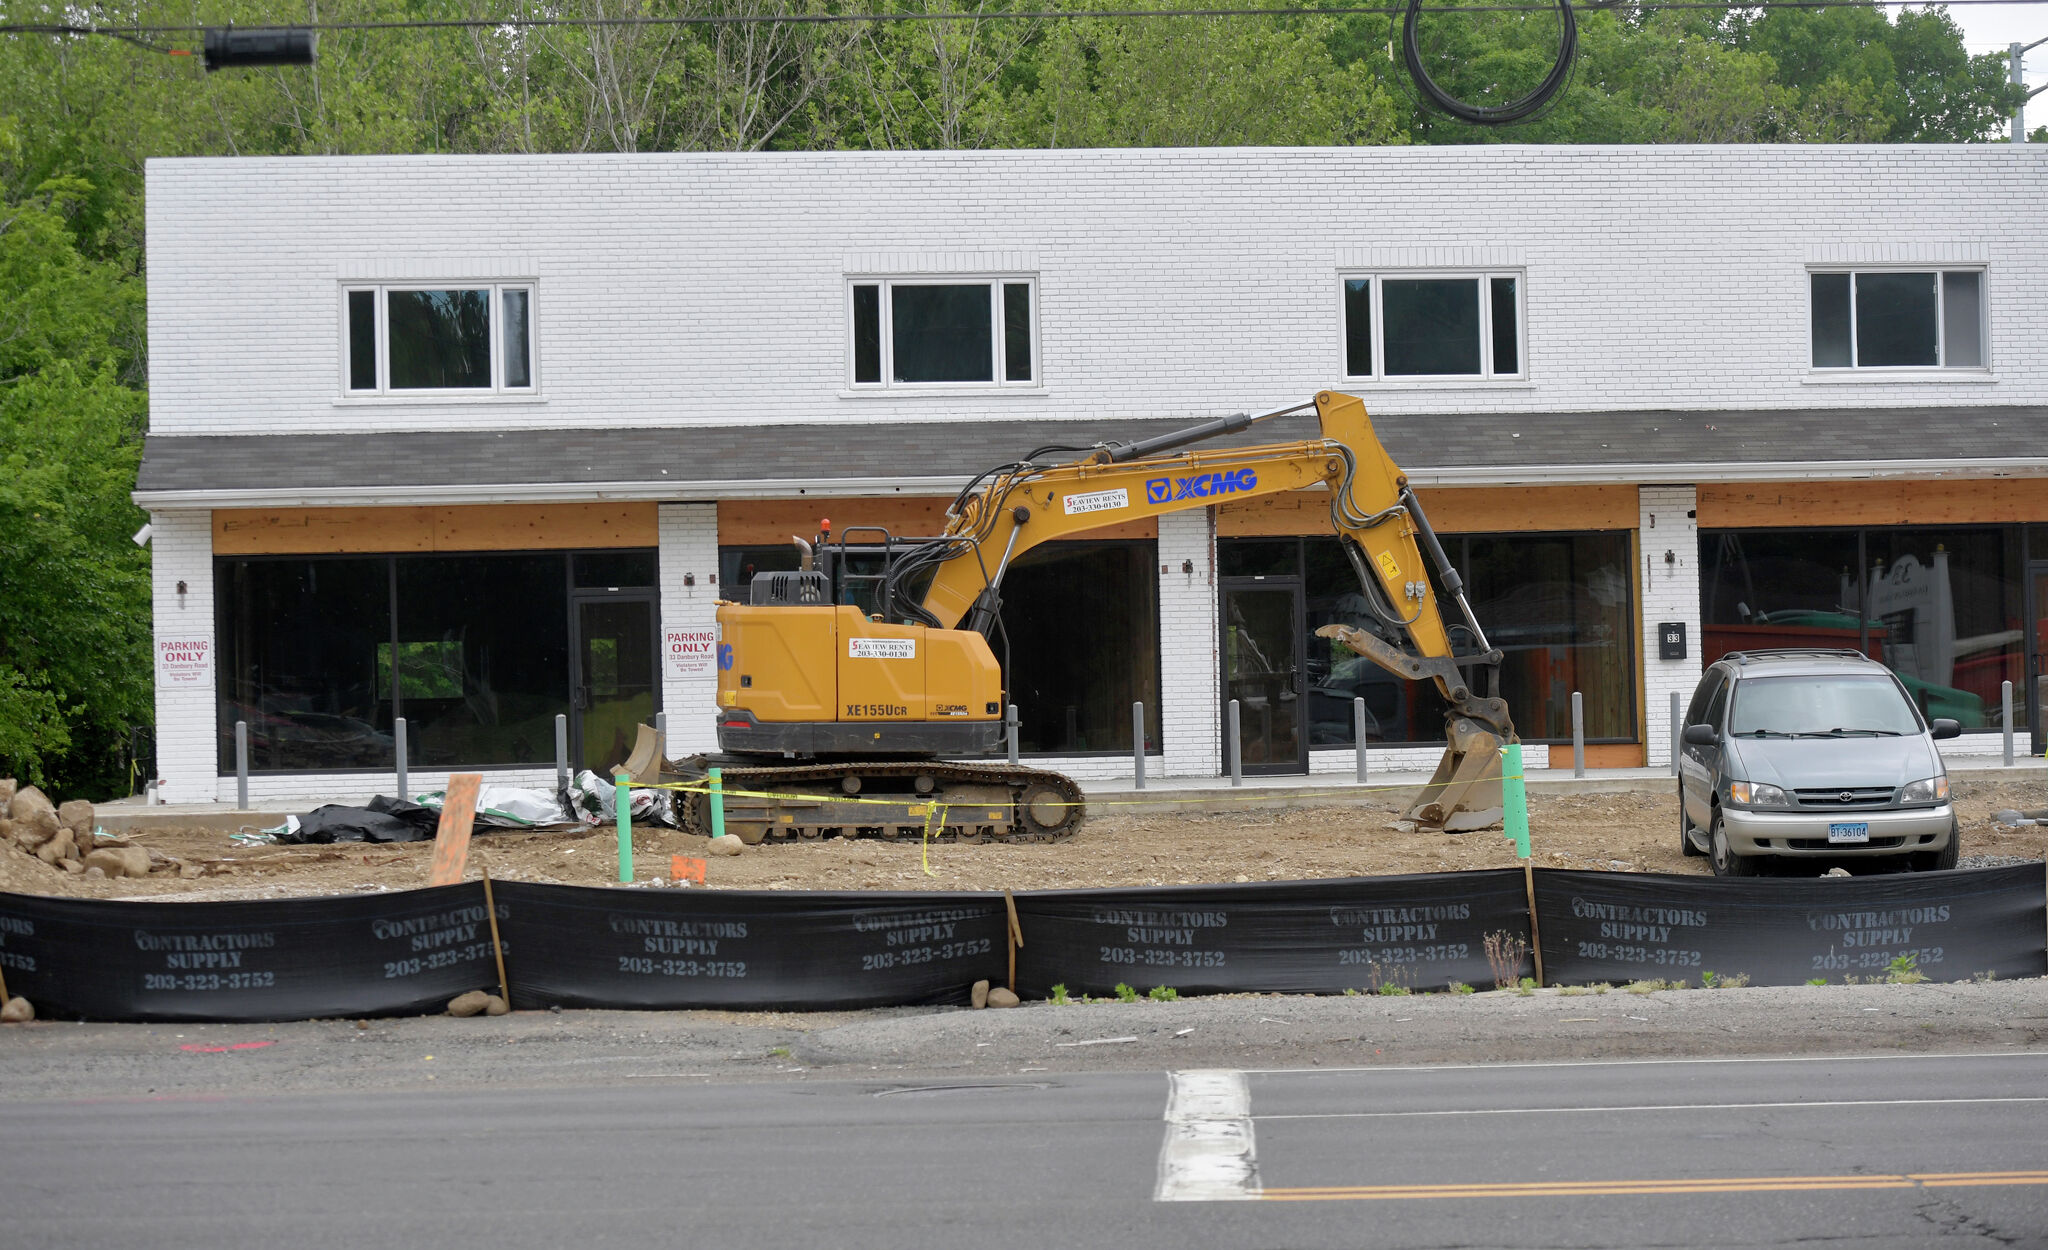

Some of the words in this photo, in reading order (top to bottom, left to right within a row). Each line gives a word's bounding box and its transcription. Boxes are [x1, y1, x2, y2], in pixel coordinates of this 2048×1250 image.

[1175, 468, 1257, 500] XCMG
[1067, 496, 1100, 507] SEAVIEW
[1102, 494, 1126, 502] RENTS
[1072, 501, 1121, 513] 203-330-0130
[160, 641, 208, 651] PARKING
[668, 632, 714, 642] PARKING
[852, 640, 886, 650] SEAVIEW
[1668, 634, 1679, 642] 33
[165, 652, 204, 662] ONLY
[672, 643, 710, 653] ONLY
[857, 650, 908, 658] 203-330-0130
[846, 704, 907, 716] XE155UCR
[1330, 904, 1471, 927] CONTRACTORS
[1571, 896, 1707, 927] CONTRACTORS
[1808, 905, 1951, 932] CONTRACTORS
[609, 914, 748, 938] CONTRACTORS
[886, 922, 956, 946] SUPPLY
[1127, 927, 1195, 945] SUPPLY
[1363, 924, 1438, 943] SUPPLY
[1601, 921, 1671, 943] SUPPLY
[135, 930, 275, 951] CONTRACTORS
[411, 923, 477, 952] SUPPLY
[644, 936, 718, 956] SUPPLY
[1842, 927, 1913, 948] SUPPLY
[166, 951, 242, 969] SUPPLY
[862, 939, 992, 970] 203-323-3752
[1100, 946, 1226, 967] 203-323-3752
[1339, 943, 1470, 965] 203-323-3752
[1578, 941, 1702, 967] 203-323-3752
[619, 956, 747, 978] 203-323-3752
[144, 971, 275, 991] 203-323-3752
